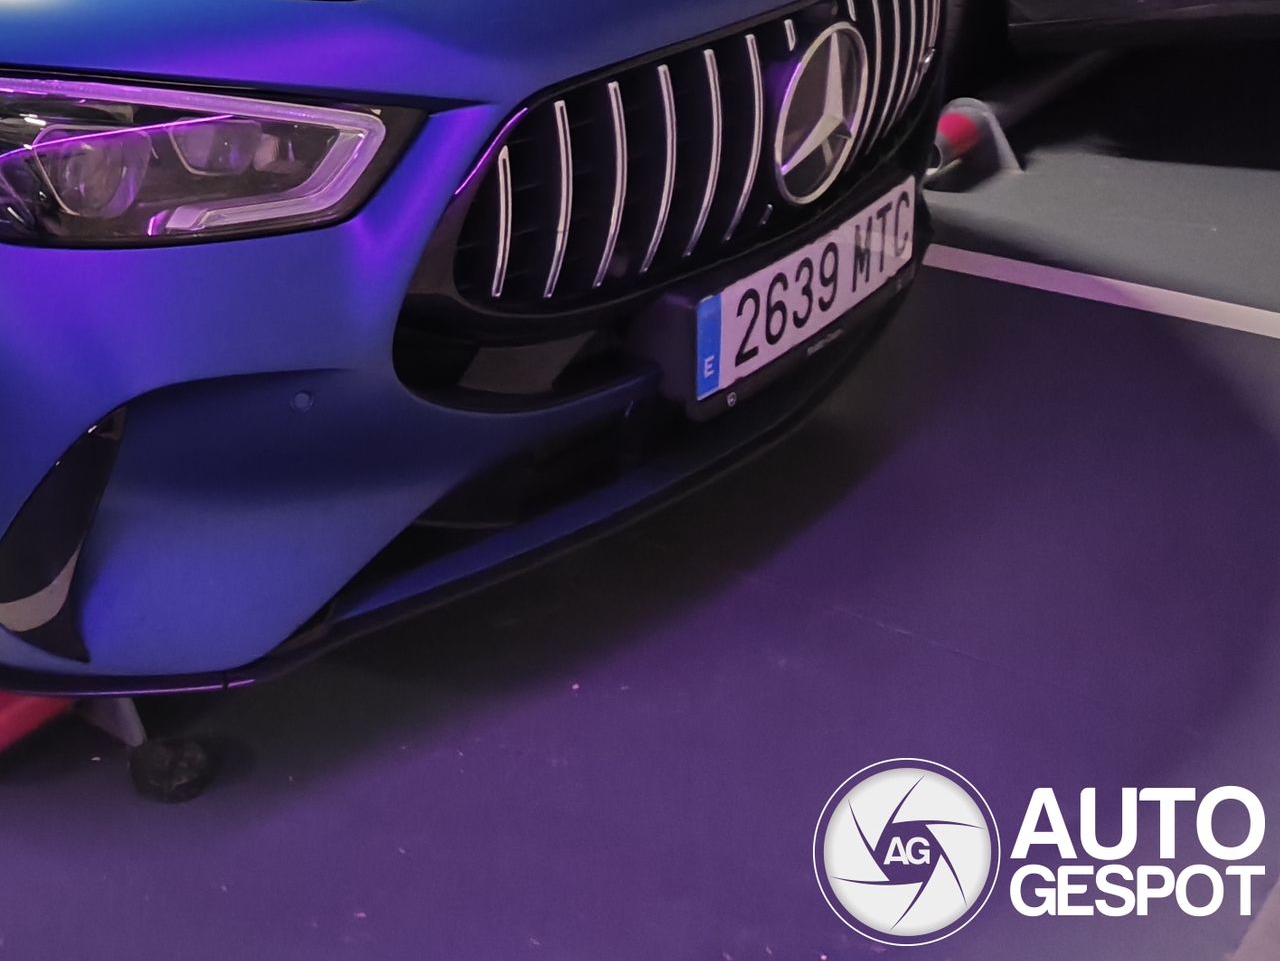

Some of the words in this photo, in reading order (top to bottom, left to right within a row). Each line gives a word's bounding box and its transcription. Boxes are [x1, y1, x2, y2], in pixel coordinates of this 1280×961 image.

[734, 241, 839, 367] 2639
[852, 190, 910, 293] MTC
[703, 355, 715, 379] E
